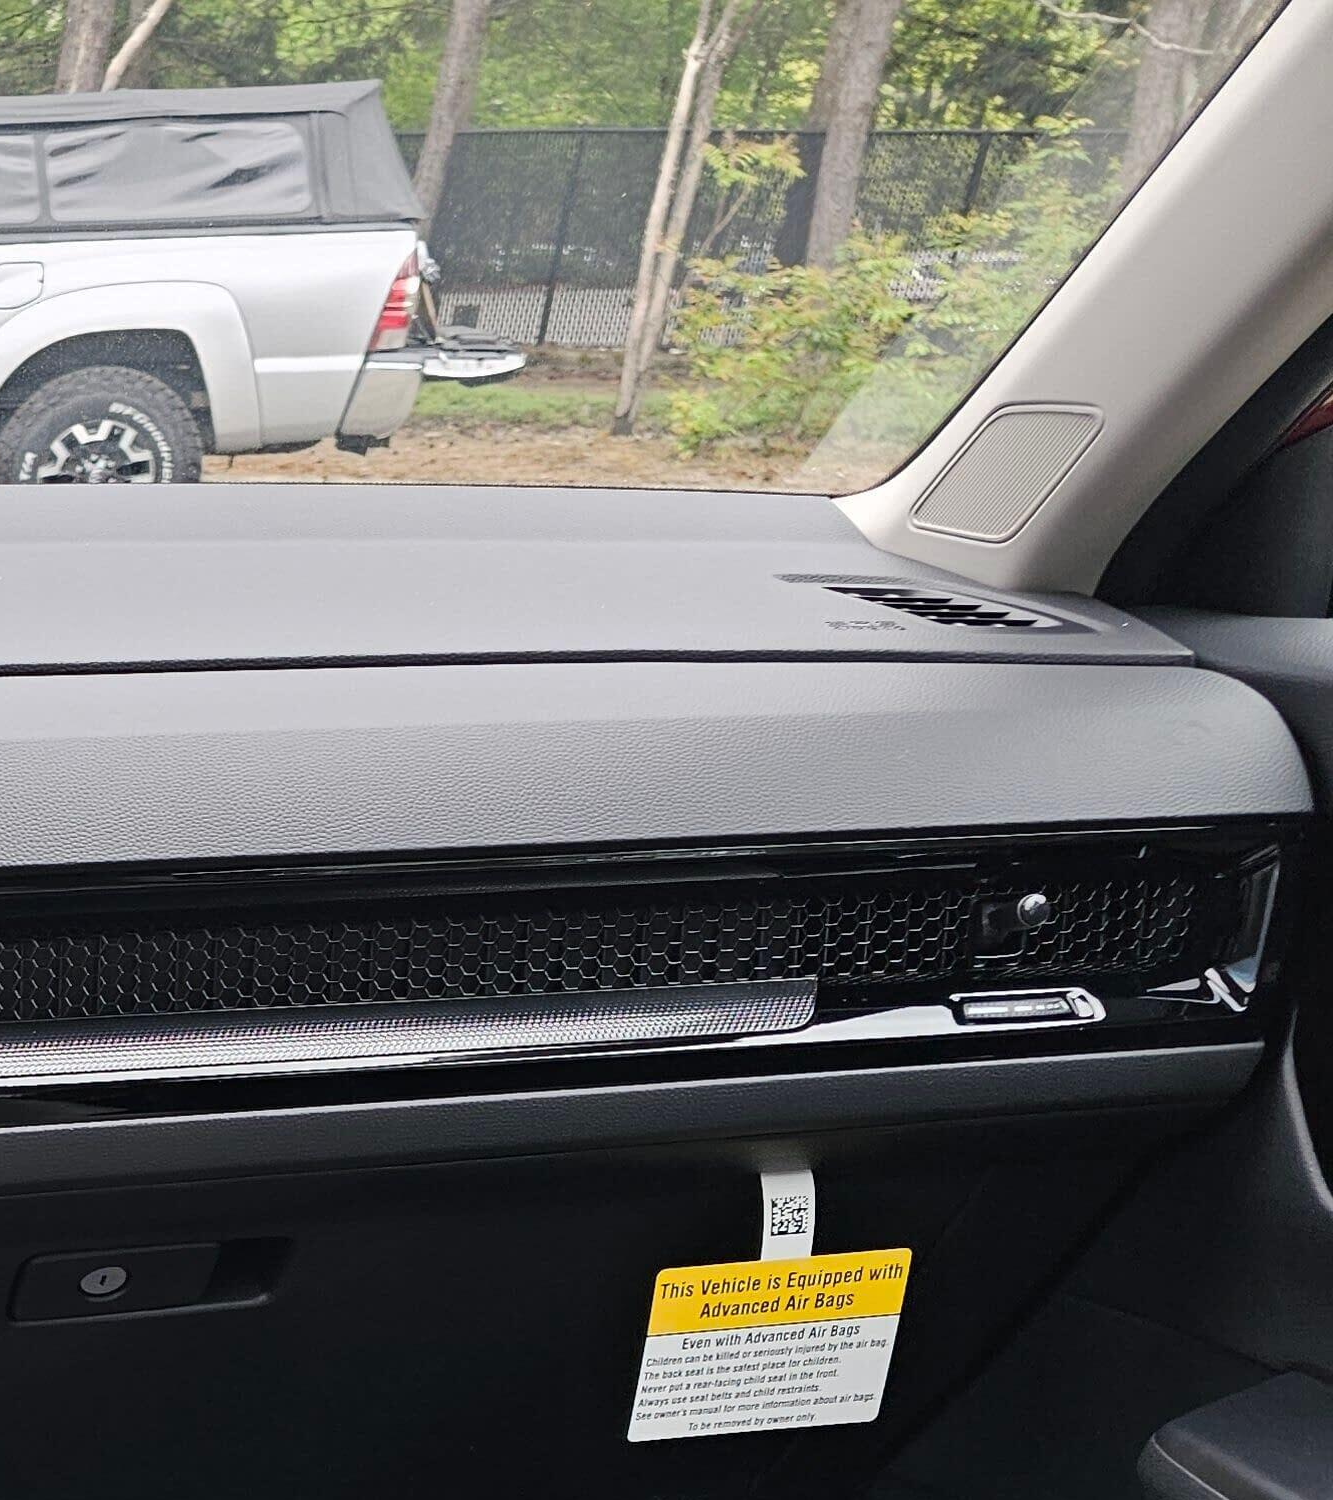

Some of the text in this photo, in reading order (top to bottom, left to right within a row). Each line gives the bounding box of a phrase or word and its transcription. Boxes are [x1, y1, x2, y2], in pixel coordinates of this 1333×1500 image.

[661, 1263, 903, 1299] This Vehicle is Equipped with
[699, 1292, 854, 1318] Advanced Air Bags
[681, 1324, 861, 1350] Even with Advanced Air Bags
[646, 1356, 683, 1367] Children
[684, 1355, 700, 1363] can
[702, 1354, 713, 1362] be
[715, 1351, 740, 1360] killed
[742, 1350, 752, 1359] or
[753, 1345, 793, 1357] seriously
[795, 1343, 826, 1355] injured
[827, 1342, 839, 1352] by
[840, 1340, 853, 1350] the
[856, 1339, 868, 1348] air
[644, 1356, 842, 1380] The back seat is the safest place for children.
[641, 1384, 666, 1394] Never
[668, 1382, 684, 1393] put
[693, 1377, 741, 1389] rear-facing
[744, 1374, 765, 1385] child
[767, 1373, 786, 1383] seat
[789, 1372, 798, 1380] in
[800, 1370, 813, 1379] the
[636, 1411, 652, 1421] See
[654, 1408, 687, 1419] owner's
[689, 1405, 722, 1416] manual
[723, 1403, 735, 1413] for
[737, 1402, 760, 1411] more
[762, 1397, 811, 1410] information
[813, 1395, 837, 1405] about
[839, 1393, 852, 1403] air
[638, 1384, 822, 1409] Always use seat belts and child restraints.
[688, 1413, 816, 1431] To be removed by owner only.
